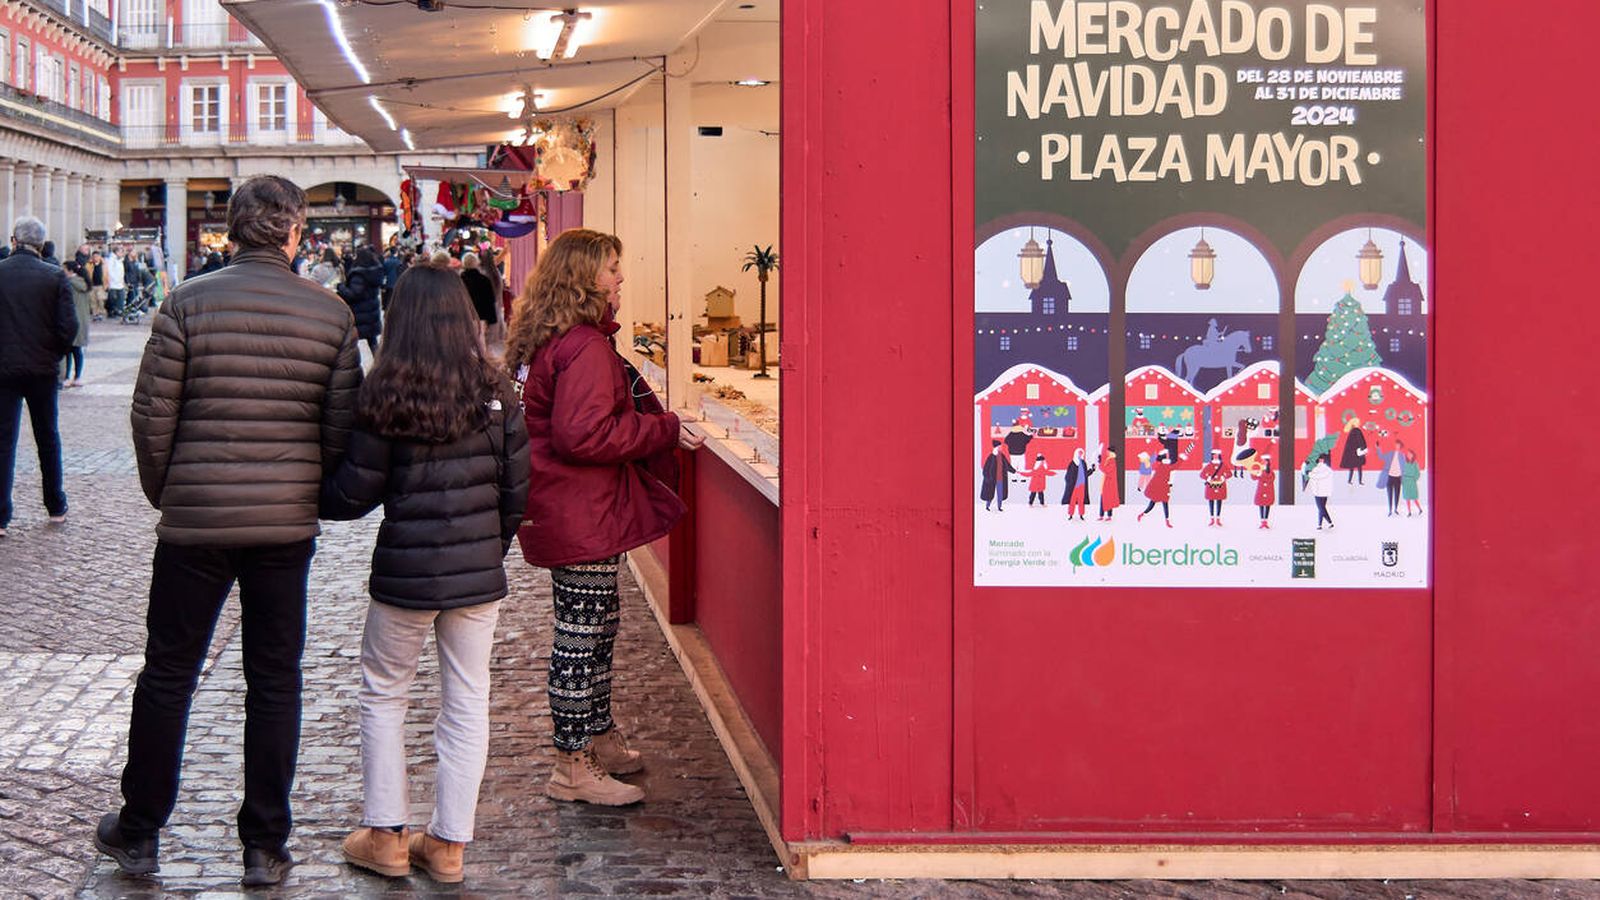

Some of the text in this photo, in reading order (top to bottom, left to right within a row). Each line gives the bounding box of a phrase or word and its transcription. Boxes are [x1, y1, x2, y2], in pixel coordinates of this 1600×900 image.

[1030, 0, 1377, 65] MERCADO DE
[1237, 70, 1403, 84] DEL 28 DE NOVIEMBRE
[1007, 62, 1228, 120] NAVIDAD
[1255, 87, 1401, 100] AL 31 DE DICIEMBRE
[1291, 106, 1355, 126] 2024
[1041, 132, 1361, 186] PLAZA MAYOR
[989, 540, 1025, 548] Mercado
[1023, 558, 1046, 566] Verde
[1122, 543, 1238, 566] Iberdrola
